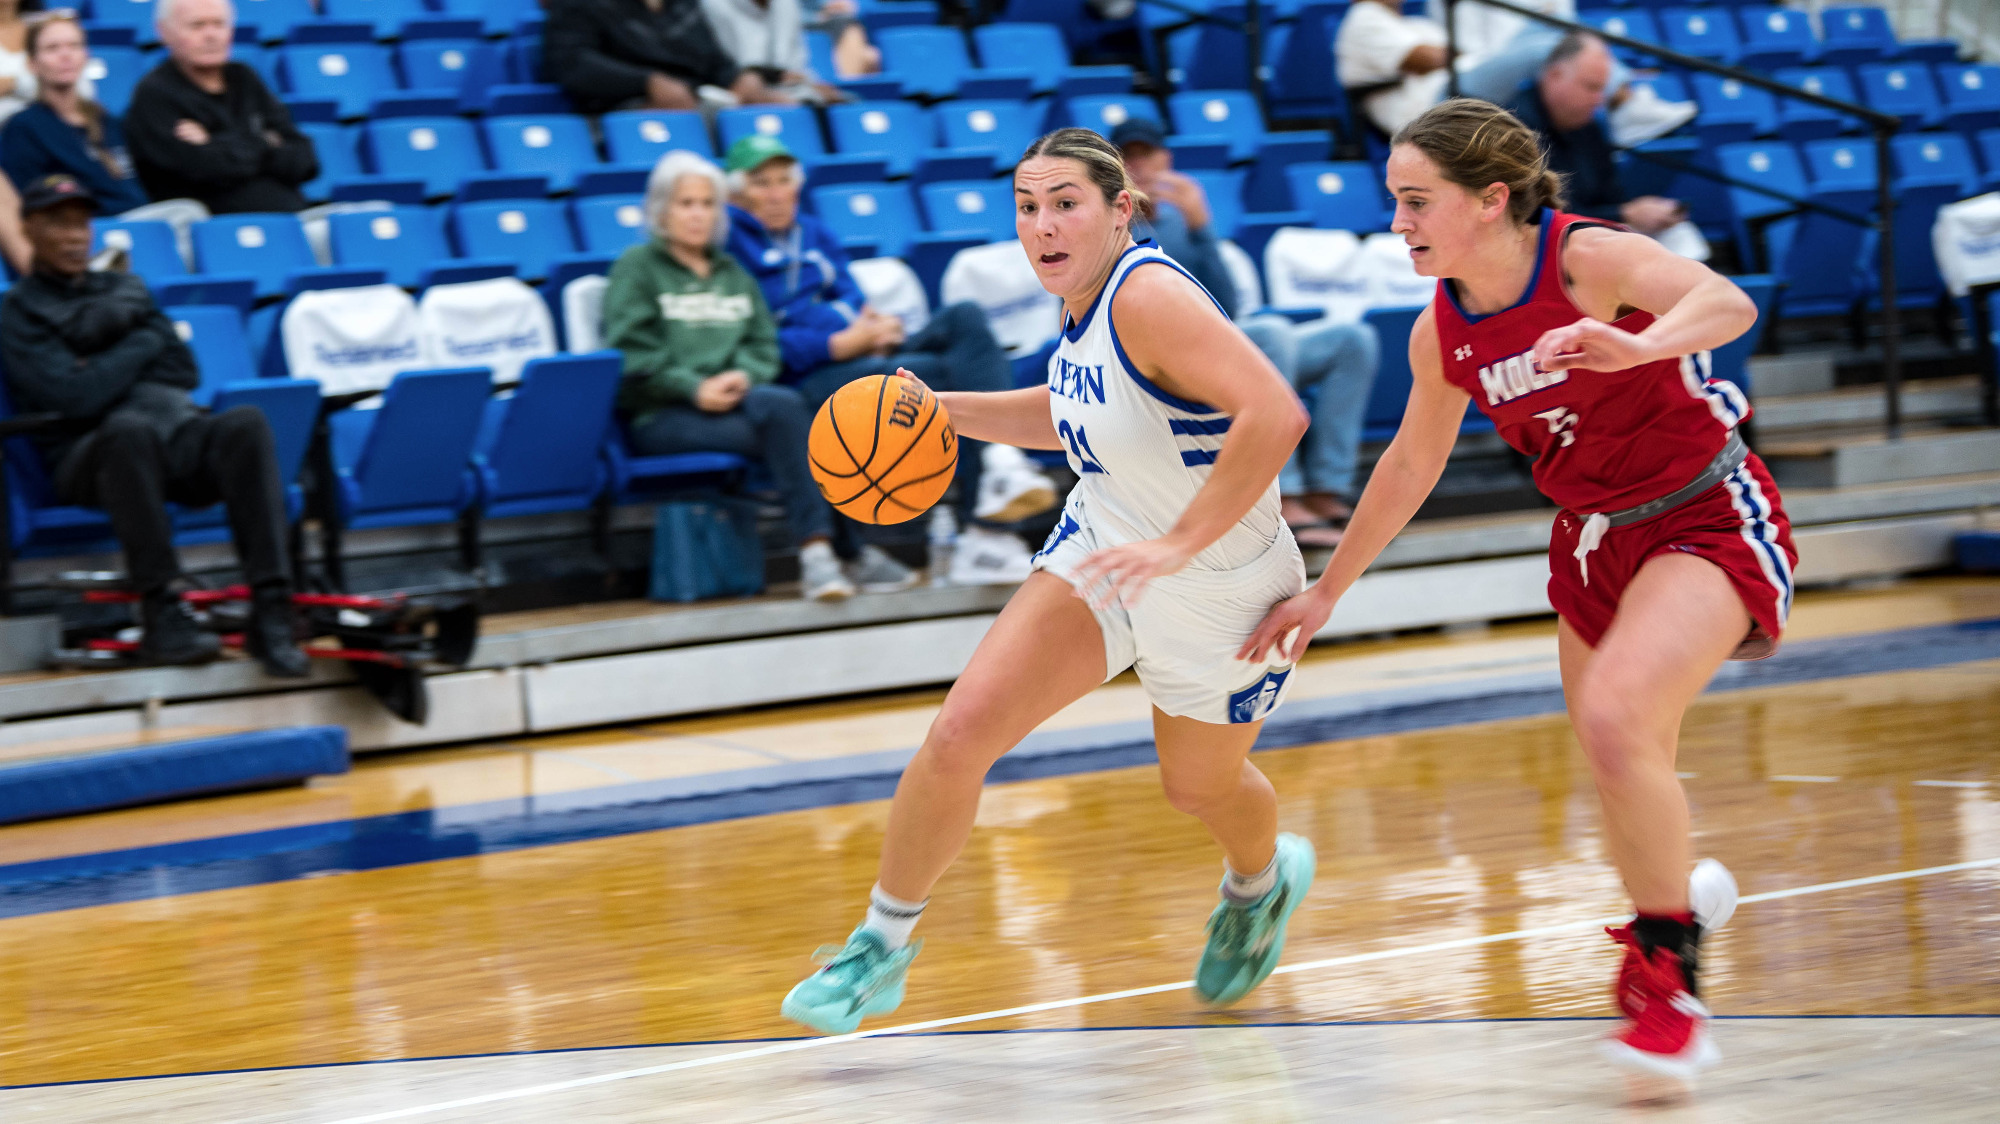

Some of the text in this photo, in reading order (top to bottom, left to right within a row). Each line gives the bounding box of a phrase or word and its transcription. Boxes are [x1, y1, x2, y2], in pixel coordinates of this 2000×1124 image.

[888, 383, 925, 429] Wil
[1530, 405, 1580, 448] 5
[1058, 418, 1111, 475] 21
